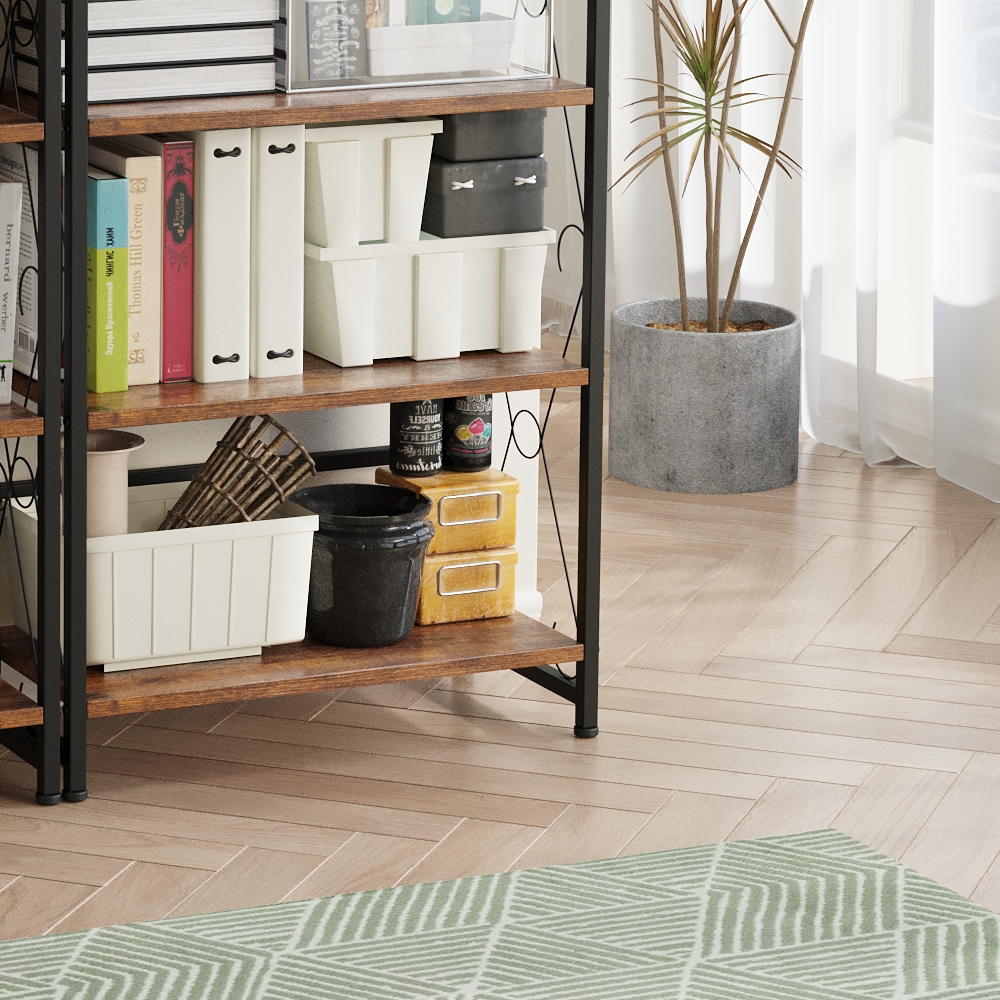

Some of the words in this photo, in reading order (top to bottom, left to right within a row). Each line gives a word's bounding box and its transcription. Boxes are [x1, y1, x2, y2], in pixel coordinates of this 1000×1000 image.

[130, 203, 143, 240] Green
[4, 224, 14, 282] bernard
[130, 244, 142, 266] Hill
[2, 291, 13, 333] werber
[129, 268, 142, 318] Thomas
